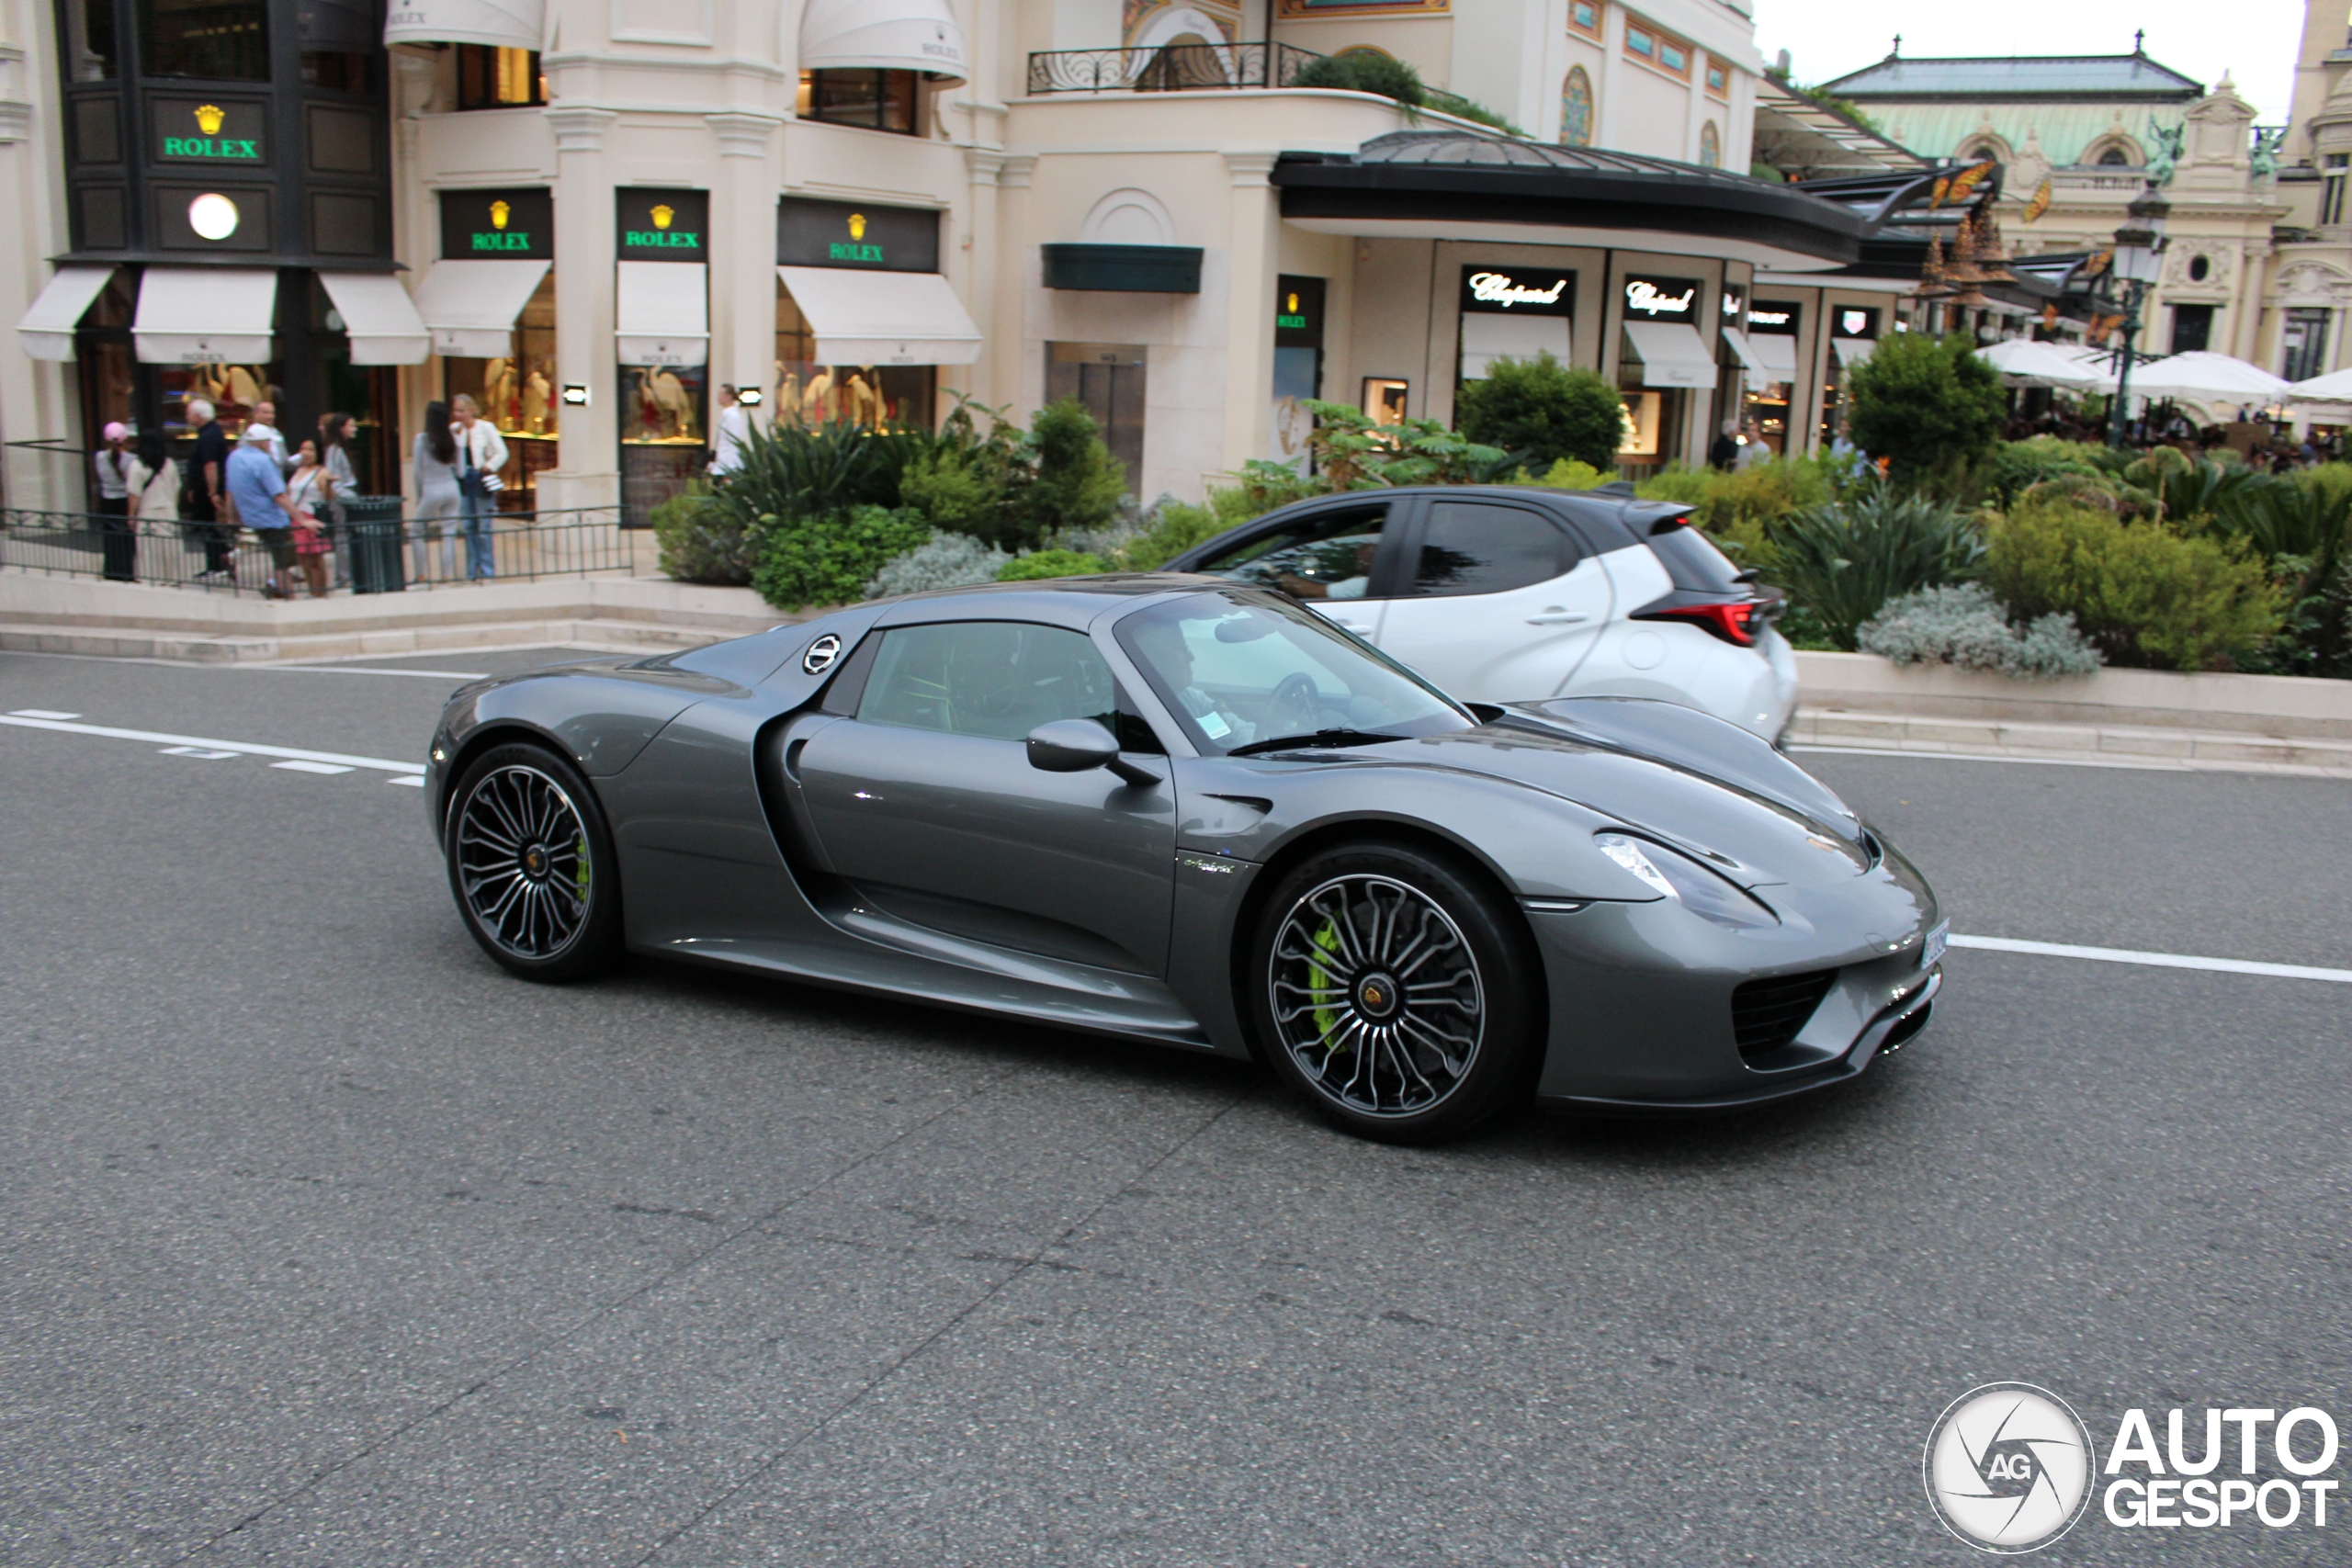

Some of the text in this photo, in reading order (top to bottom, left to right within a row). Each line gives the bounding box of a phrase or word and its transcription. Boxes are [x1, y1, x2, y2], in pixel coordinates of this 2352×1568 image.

[164, 137, 258, 158] ROLEX
[471, 232, 530, 251] ROLEX
[626, 231, 699, 248] ROLEX
[830, 243, 884, 262] ROLEX
[1469, 273, 1566, 308] Chopard
[1626, 281, 1694, 315] Chopard
